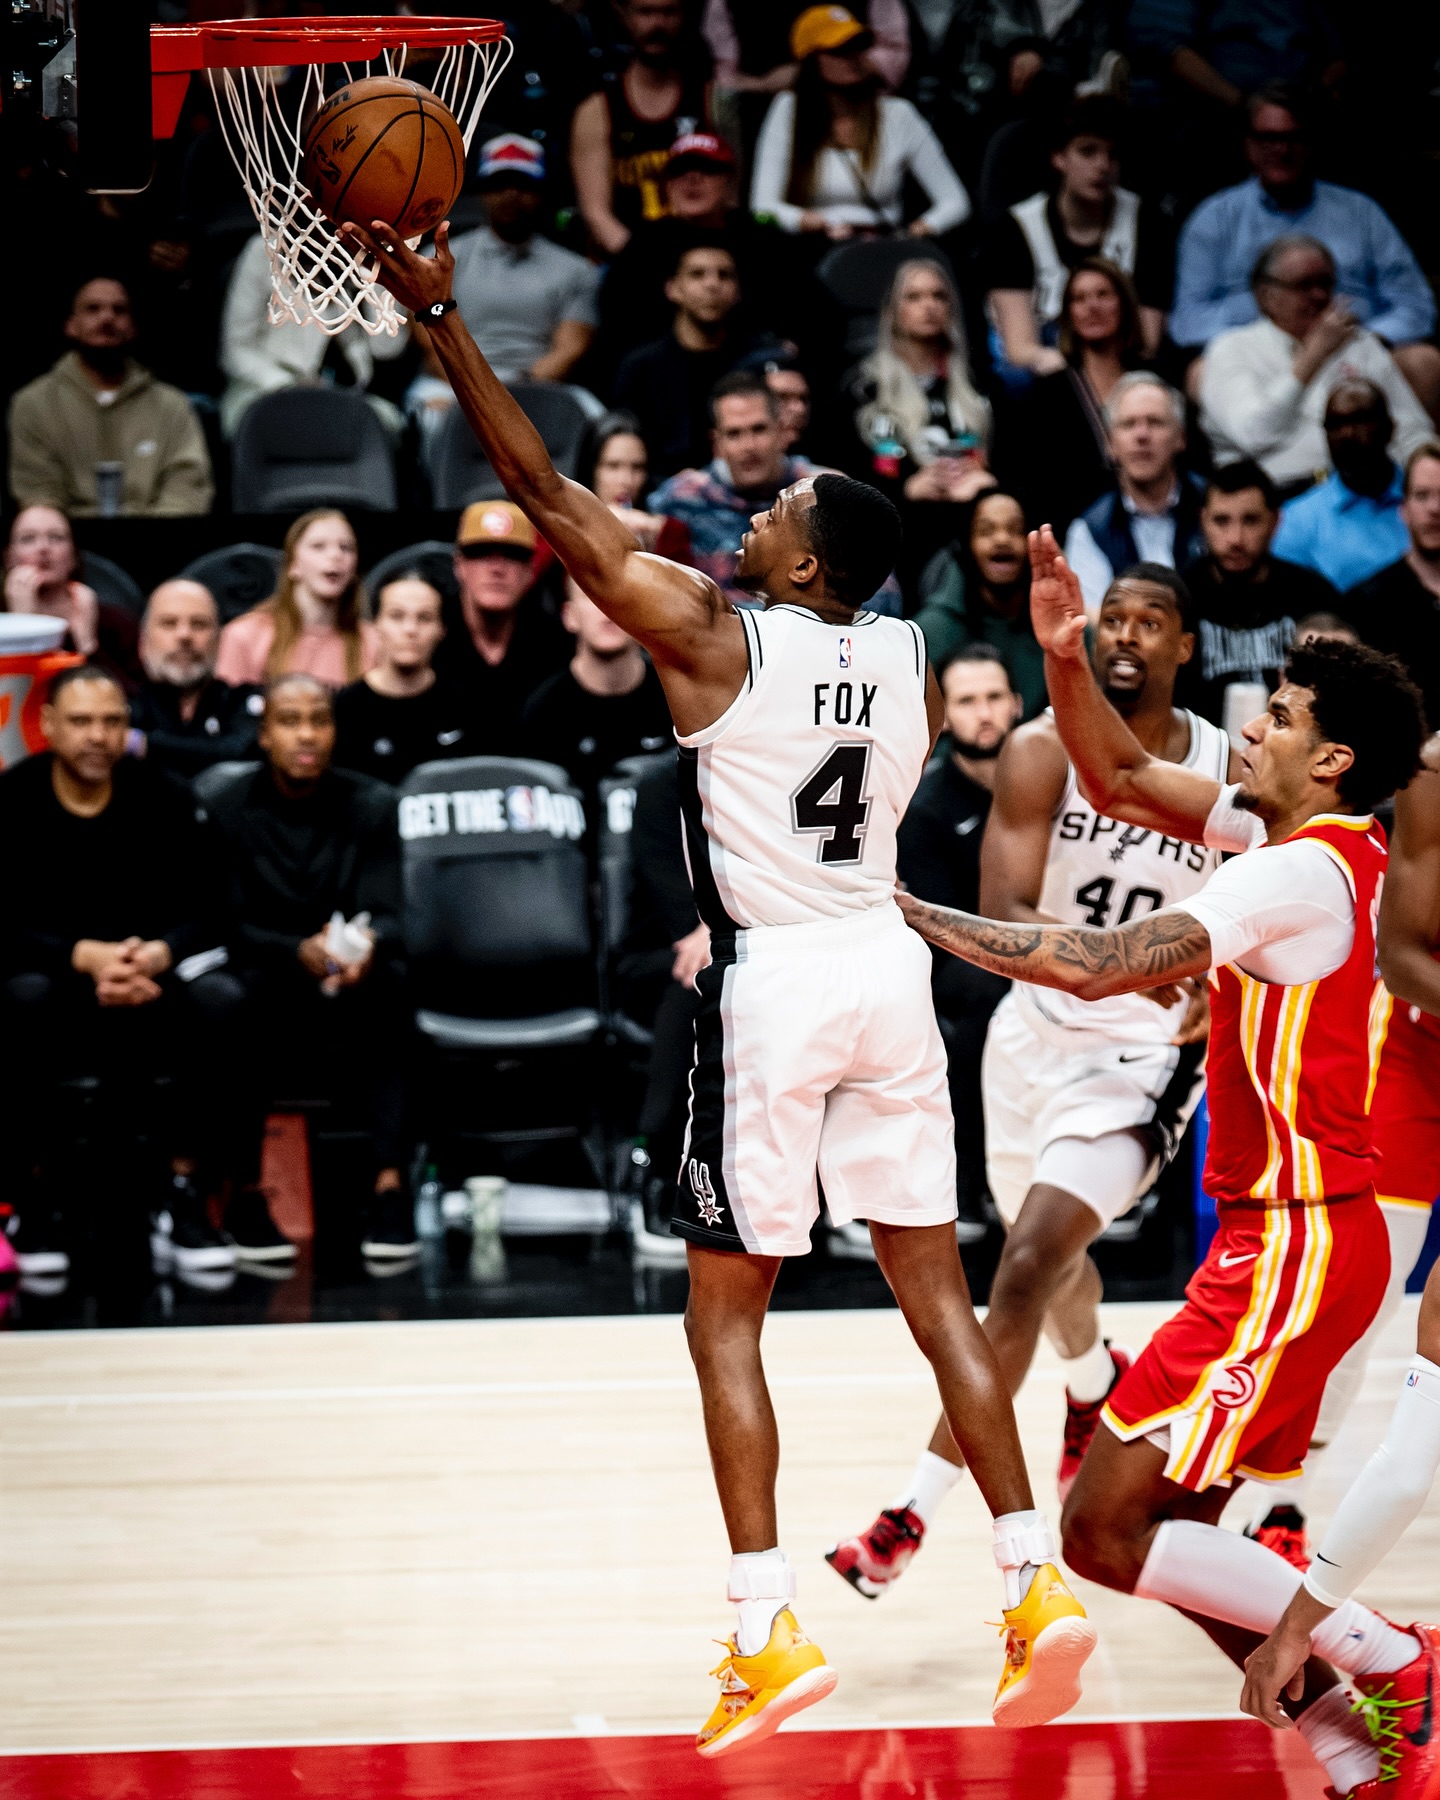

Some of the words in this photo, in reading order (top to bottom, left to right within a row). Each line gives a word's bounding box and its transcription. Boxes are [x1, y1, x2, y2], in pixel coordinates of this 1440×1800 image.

[814, 682, 878, 727] FOX
[398, 793, 451, 840] GET
[451, 788, 508, 835] THE
[788, 740, 874, 867] 4
[1059, 812, 1209, 873] SPURS
[1075, 875, 1165, 928] 40
